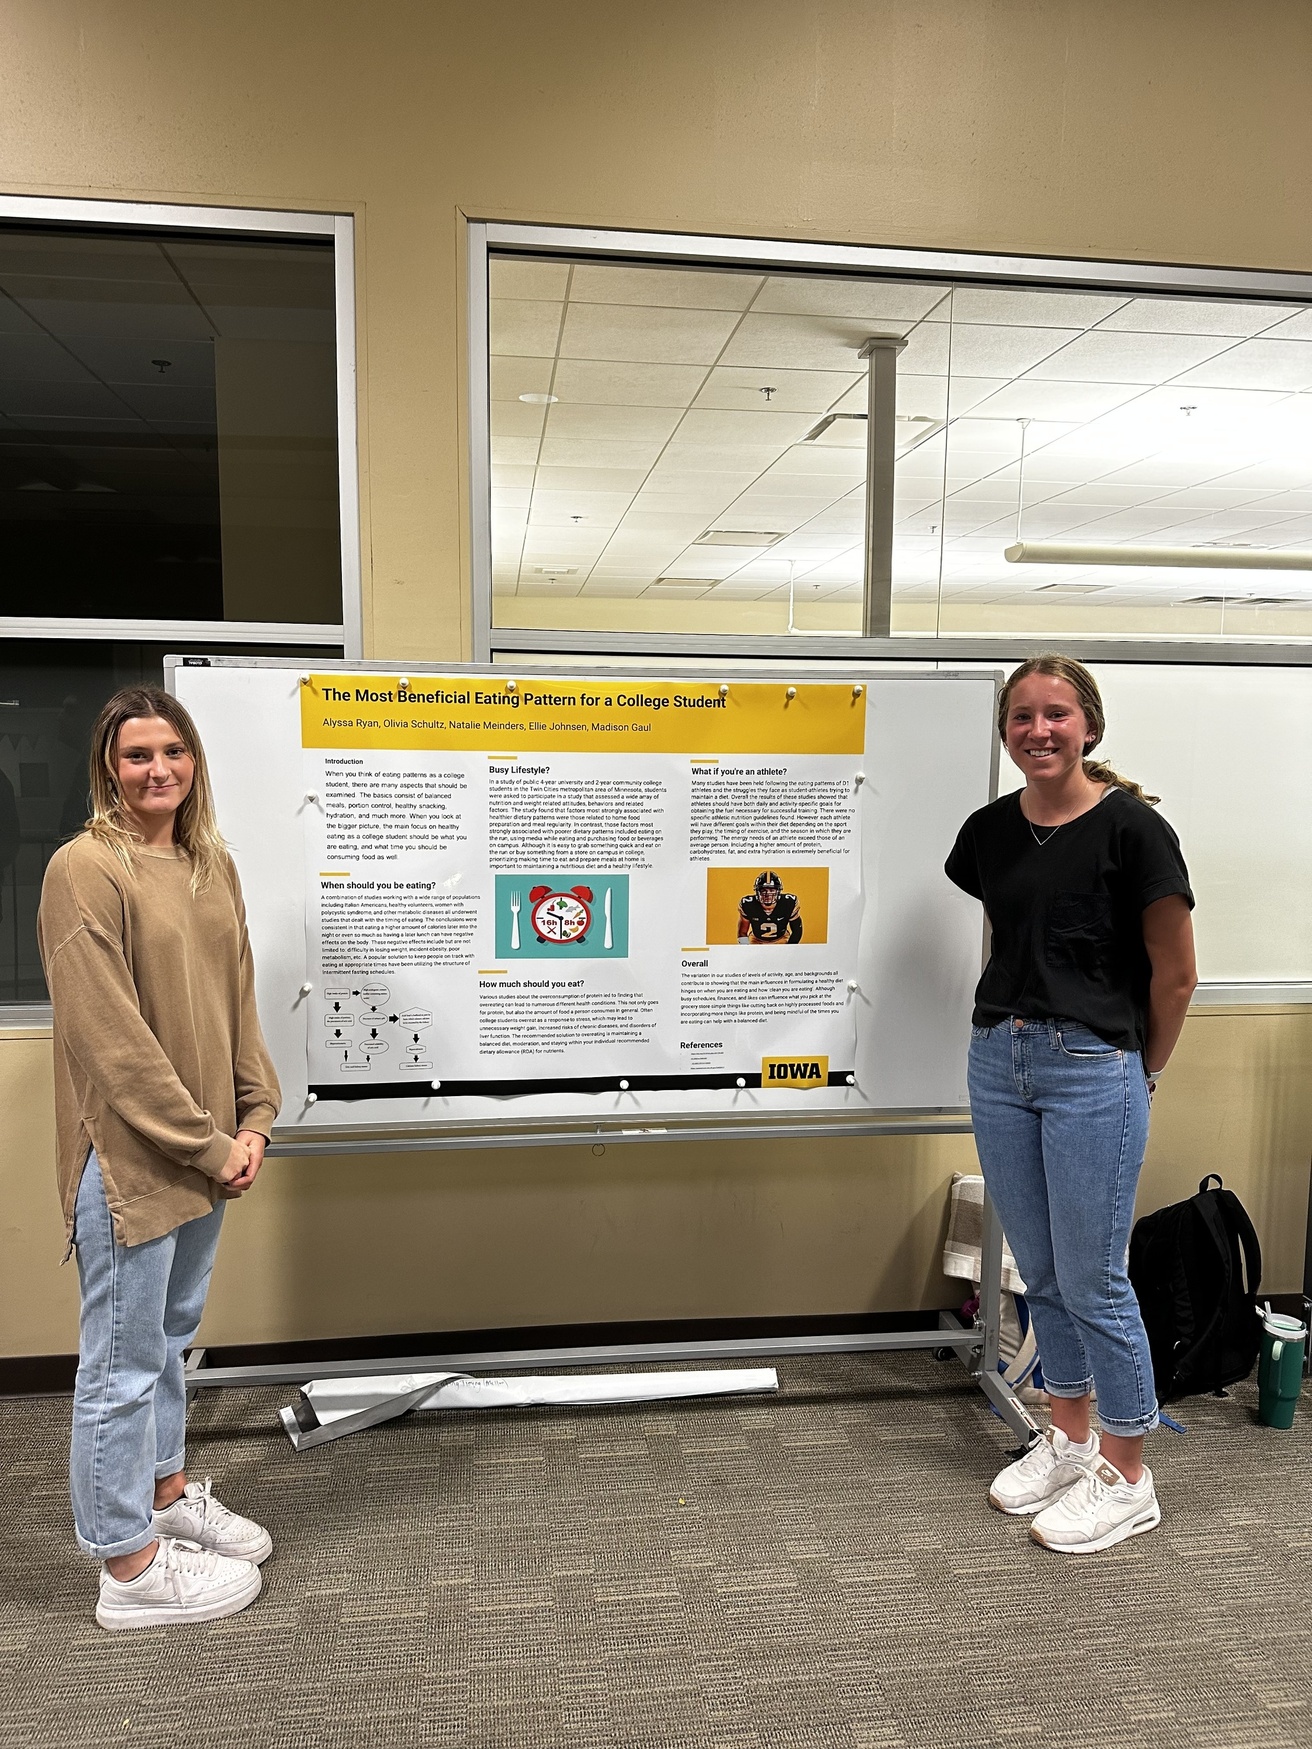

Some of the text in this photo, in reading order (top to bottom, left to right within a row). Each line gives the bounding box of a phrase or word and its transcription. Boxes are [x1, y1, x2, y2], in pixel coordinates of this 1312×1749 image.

[321, 687, 727, 710] The Most Beneficial Eating Pattern for a College Student
[322, 717, 651, 732] Alyssa Ryan, Olivia Schultz, Natalie Meinders, Ellie Johnsen, Madison Gaul
[489, 765, 550, 775] Busy Lifestyle?
[691, 767, 711, 775] What
[713, 767, 719, 775] if
[720, 767, 744, 776] you're
[756, 767, 787, 775] athlete?
[320, 881, 436, 890] When should you be eating?
[761, 923, 777, 937] 2
[681, 959, 708, 967] Overall
[479, 980, 497, 988] How
[522, 979, 549, 987] should
[550, 981, 565, 989] you
[567, 979, 584, 987] eat?
[680, 1040, 722, 1049] References
[768, 1063, 821, 1080] IOWA
